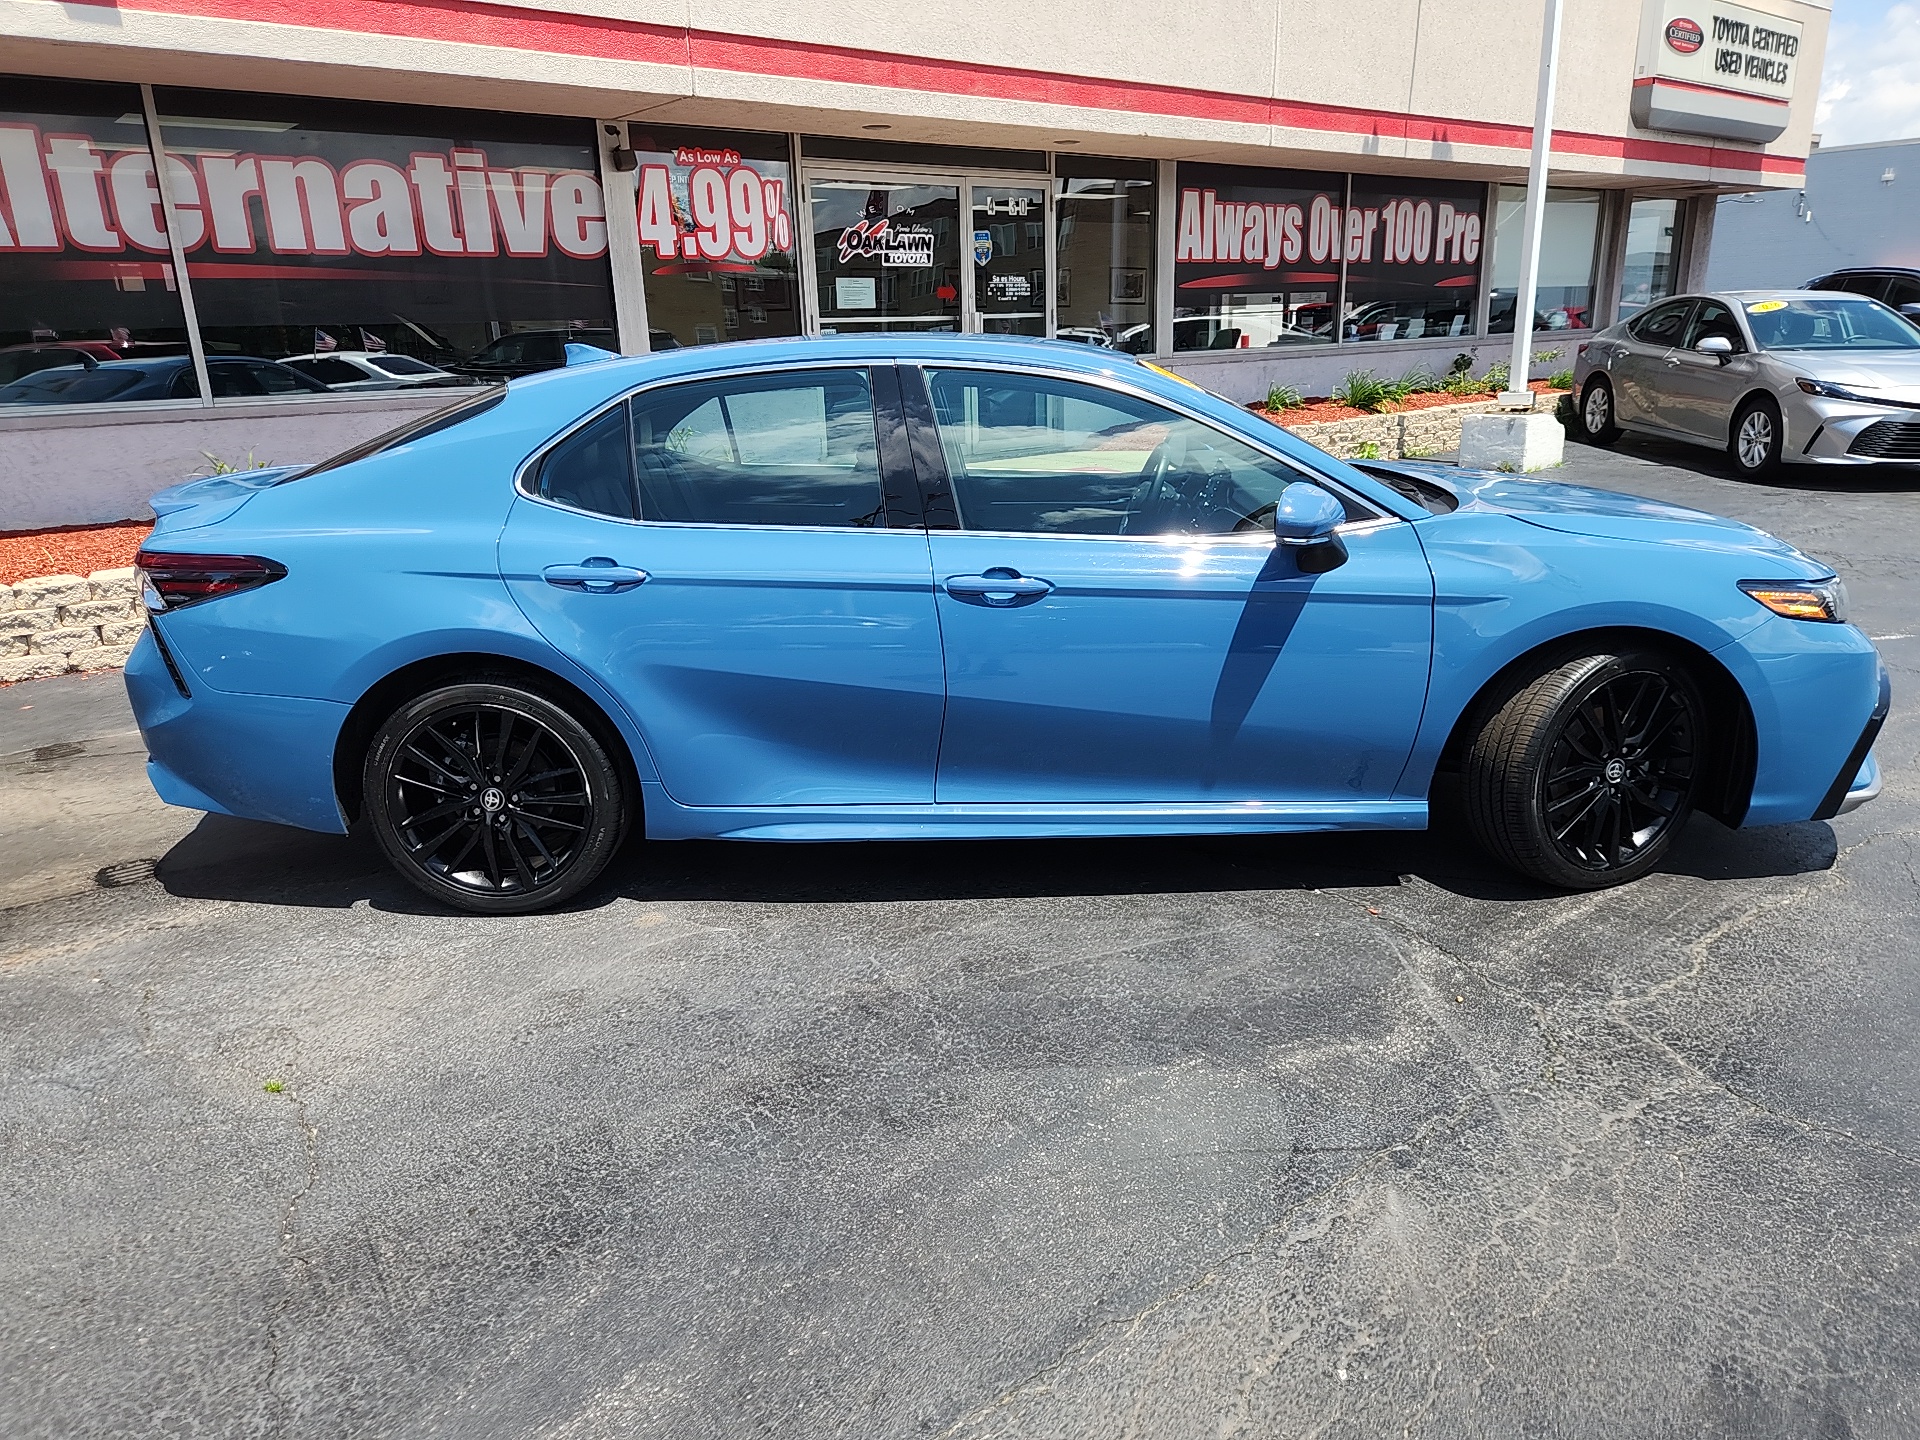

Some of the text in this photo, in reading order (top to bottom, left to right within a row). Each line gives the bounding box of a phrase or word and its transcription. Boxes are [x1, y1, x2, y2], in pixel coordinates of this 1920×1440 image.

[1669, 27, 1701, 42] CERTIFIED
[1712, 15, 1799, 57] TOYOTA CERTIFIED
[1714, 48, 1789, 85] USED VEHICLES
[679, 150, 739, 164] As Low As
[0, 127, 607, 257] lternative
[639, 166, 791, 258] 4.99%
[1177, 189, 1481, 268] Always Over 100 Pre
[888, 252, 929, 264] TOYOTA
[992, 274, 1026, 283] Saes Hours
